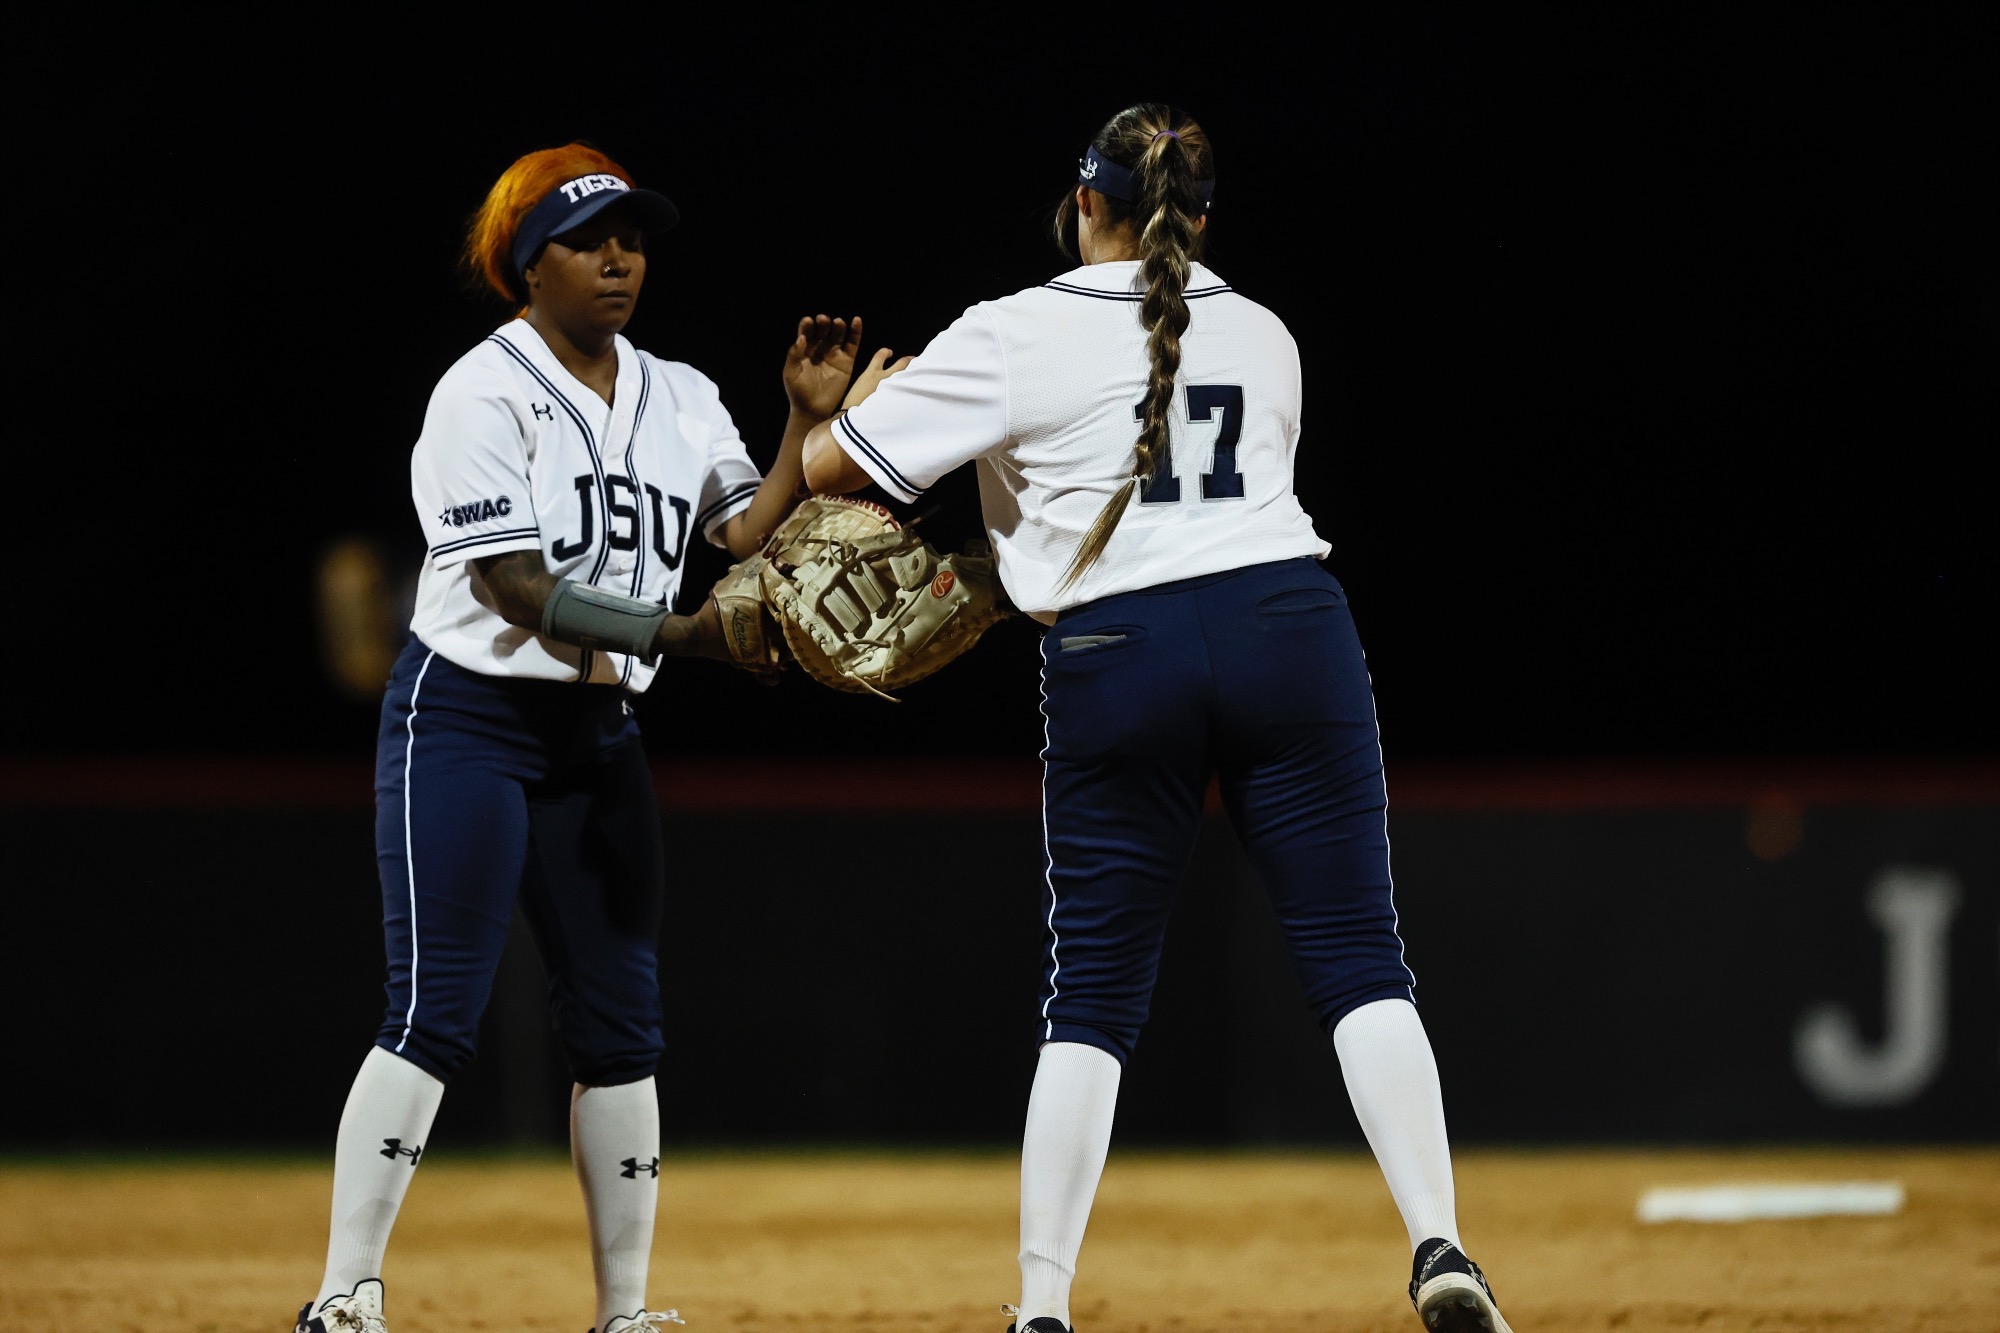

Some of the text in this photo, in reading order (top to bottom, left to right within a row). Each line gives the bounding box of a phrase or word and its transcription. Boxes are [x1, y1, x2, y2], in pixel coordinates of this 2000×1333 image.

[1132, 383, 1246, 506] 17
[451, 495, 512, 528] SWAC
[551, 473, 691, 572] JSU
